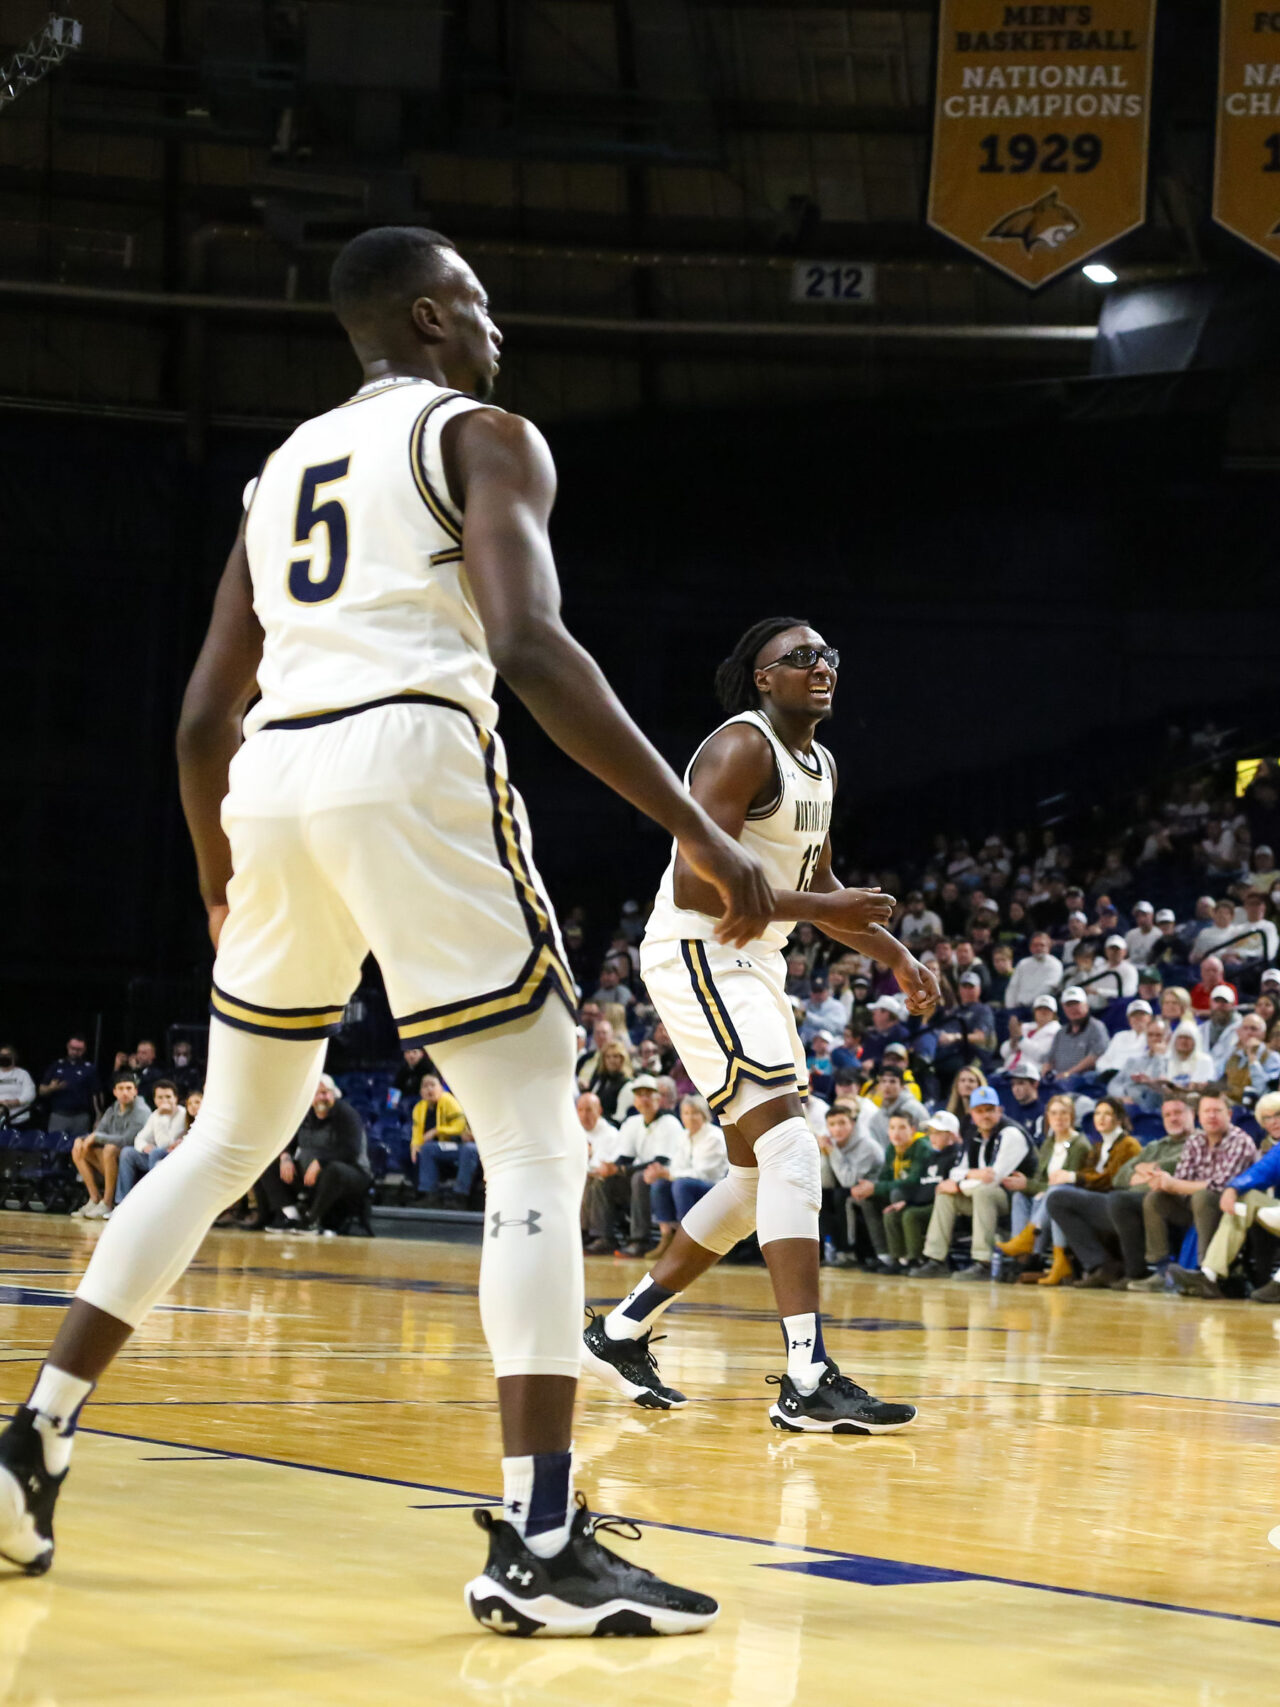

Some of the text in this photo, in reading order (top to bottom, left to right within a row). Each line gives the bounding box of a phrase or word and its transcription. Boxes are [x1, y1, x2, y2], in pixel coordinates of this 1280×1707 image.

[1003, 6, 1092, 26] MEN'S
[956, 31, 1138, 51] BASKETBALL
[961, 65, 1128, 89] NATIONAL
[943, 93, 1142, 118] CHAMPIONS
[978, 132, 1103, 173] 1929
[806, 266, 862, 298] 212
[284, 451, 354, 607] 5
